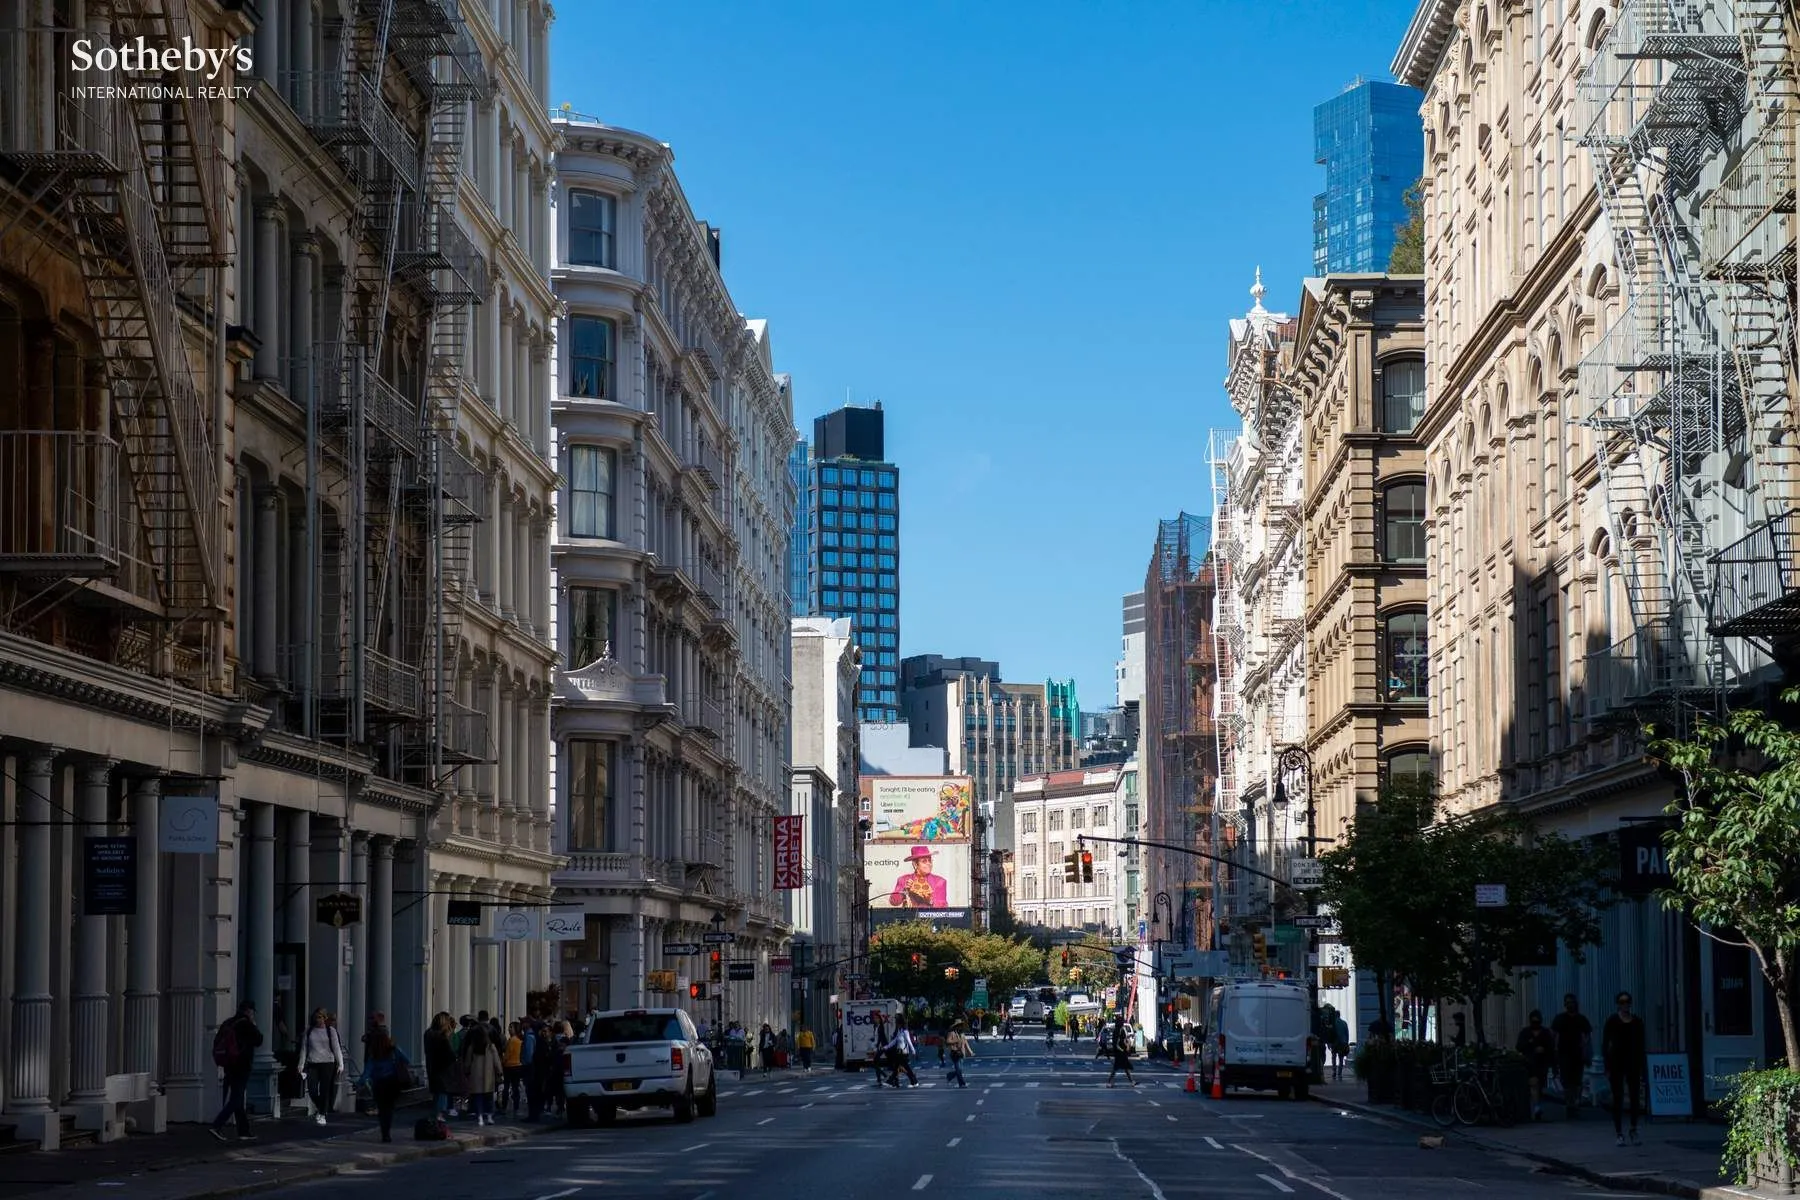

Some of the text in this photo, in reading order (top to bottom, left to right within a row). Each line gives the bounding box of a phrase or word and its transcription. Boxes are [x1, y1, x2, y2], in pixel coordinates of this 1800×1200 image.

[917, 786, 936, 795] eating
[777, 819, 788, 886] KIRNA
[1636, 845, 1669, 875] PAI
[874, 859, 900, 868] eating
[448, 916, 480, 925] ARGENT
[546, 918, 582, 935] Rails
[846, 1010, 889, 1025] Fedx
[1652, 1064, 1685, 1080] PAIGE
[1655, 1084, 1686, 1097] NEW
